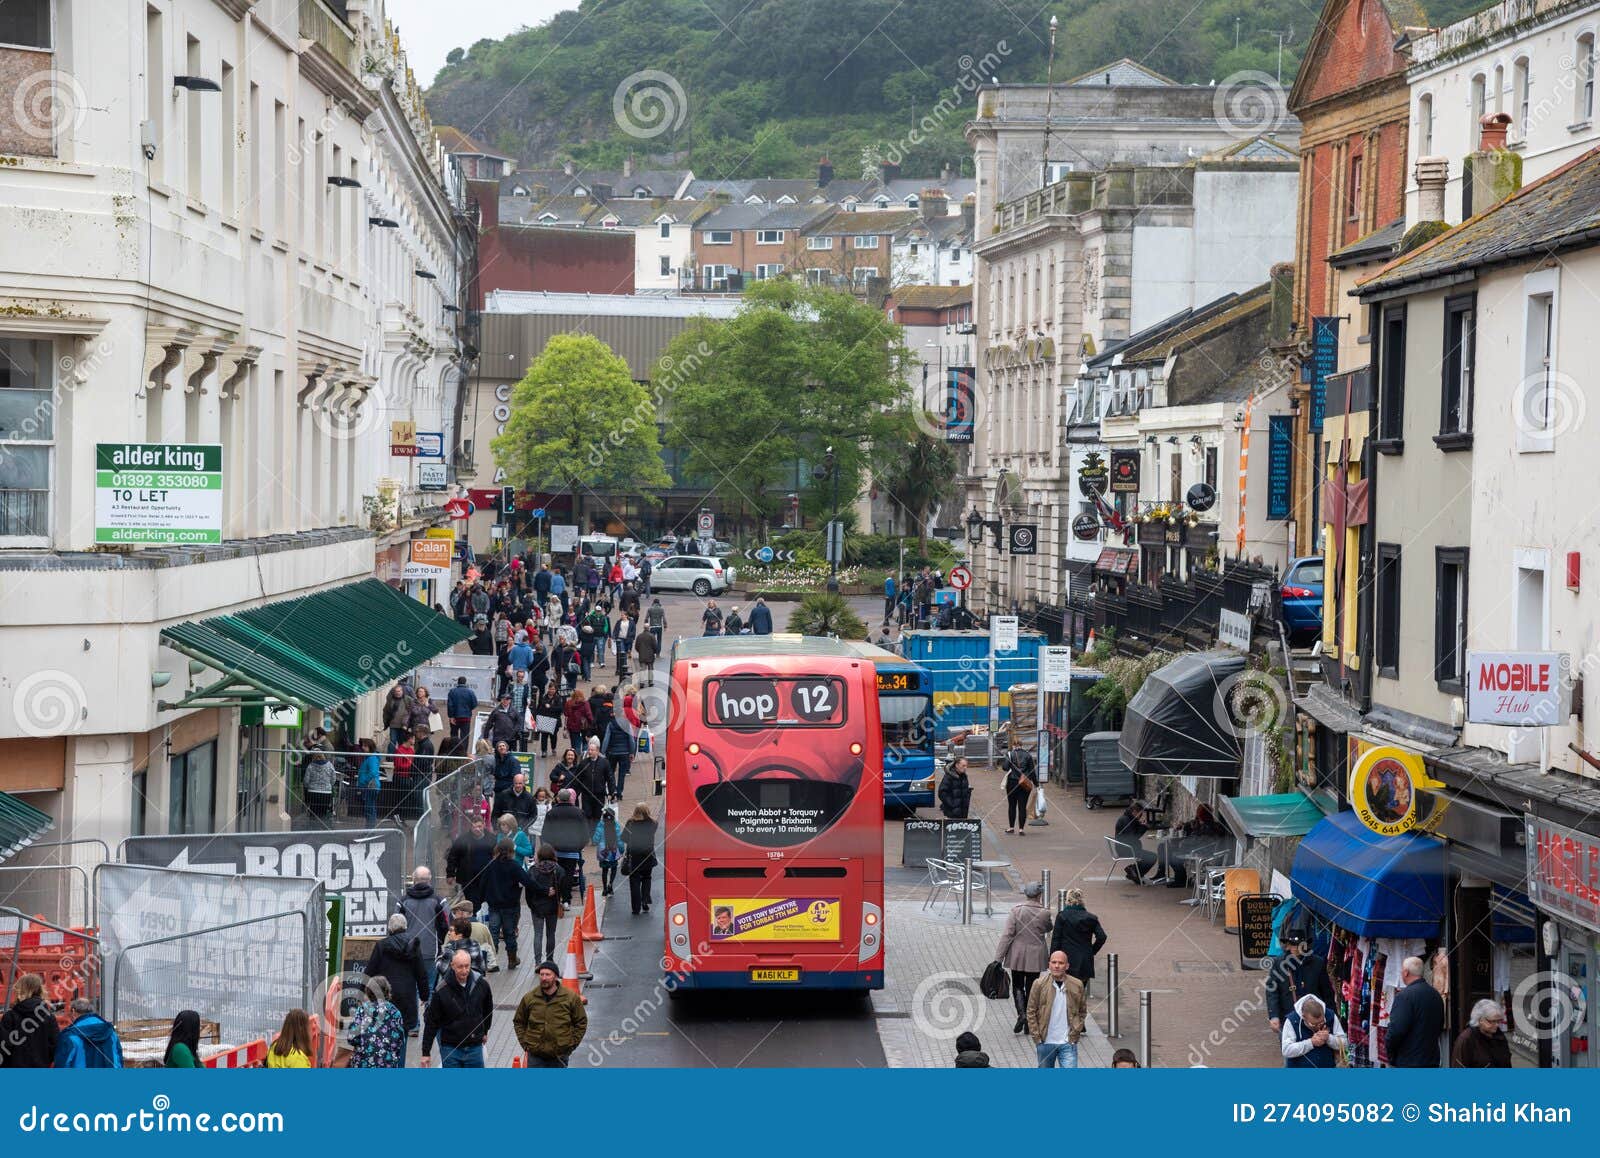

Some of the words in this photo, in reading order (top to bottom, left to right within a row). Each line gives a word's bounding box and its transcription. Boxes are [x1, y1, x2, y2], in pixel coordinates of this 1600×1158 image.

[113, 445, 162, 466] alder
[165, 446, 205, 471] king
[112, 474, 153, 487] 01392
[157, 475, 208, 488] 353080
[113, 489, 133, 502] TO
[139, 490, 168, 502] LET
[112, 529, 208, 542] alderking.com
[893, 674, 907, 689] 34
[1478, 663, 1550, 692] MOBILE
[721, 692, 774, 720] hop
[797, 685, 832, 714] 12
[1495, 695, 1530, 714] Hub
[727, 808, 757, 816] Newton
[758, 808, 781, 816] Abbot
[788, 808, 818, 818] Torquay
[740, 817, 773, 826] Paignton
[781, 817, 812, 825] Brixham
[1360, 809, 1379, 830] 0845
[755, 826, 776, 834] every
[788, 825, 817, 833] minutes
[244, 842, 388, 890] ROCK
[1536, 826, 1600, 905] MOBILE
[737, 915, 752, 924] VOTE
[752, 910, 767, 919] TONY
[740, 922, 752, 930] FOR
[753, 915, 774, 926] TORBAY
[786, 905, 798, 915] MAY
[757, 970, 776, 979] WA61
[777, 970, 793, 979] KLF
